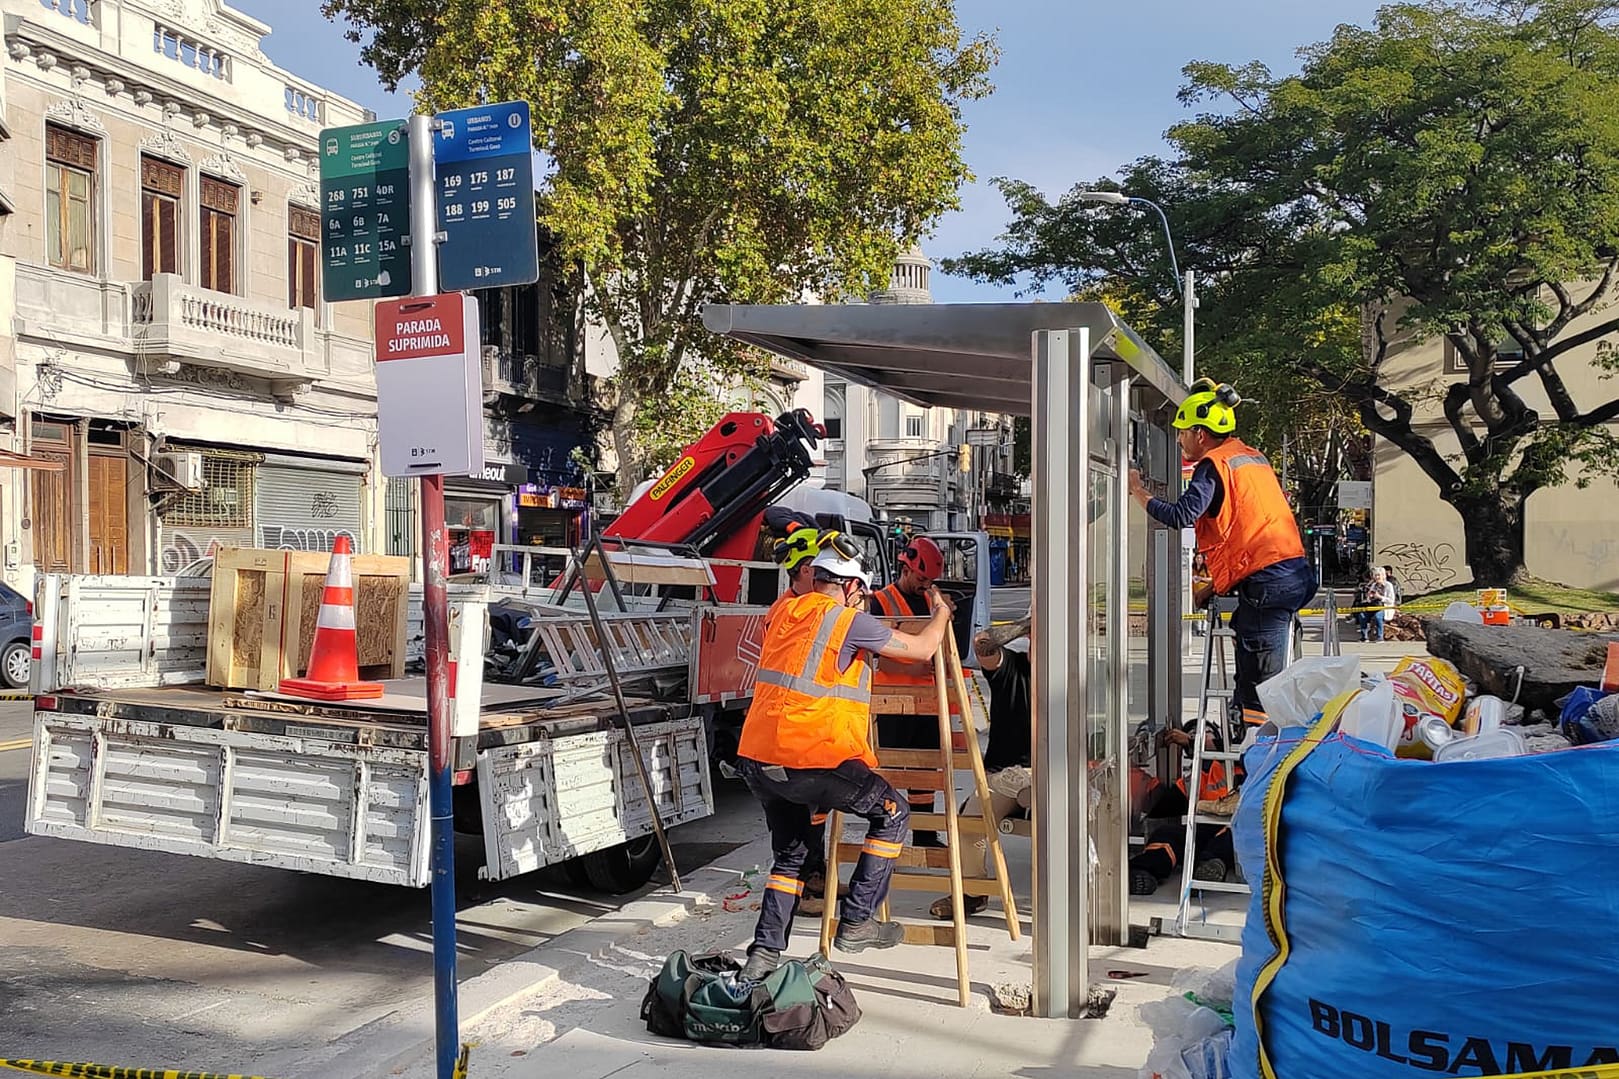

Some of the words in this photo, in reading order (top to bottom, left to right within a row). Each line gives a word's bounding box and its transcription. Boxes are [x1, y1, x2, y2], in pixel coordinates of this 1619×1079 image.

[467, 115, 492, 124] URBANOS
[444, 175, 462, 188] 169
[470, 171, 488, 185] 175
[496, 168, 515, 181] 187
[328, 190, 345, 202] 268
[352, 187, 368, 199] 751
[445, 203, 463, 216] 188
[471, 200, 490, 213] 199
[497, 197, 516, 210] 505
[329, 219, 341, 230] 6A
[353, 216, 365, 227] 6B
[377, 212, 389, 224] 7A
[330, 246, 347, 257] 11A
[378, 240, 396, 251] 15A
[396, 318, 441, 335] PARADA
[388, 334, 450, 353] SUPRIMIDA
[651, 459, 693, 498] PALFINGER
